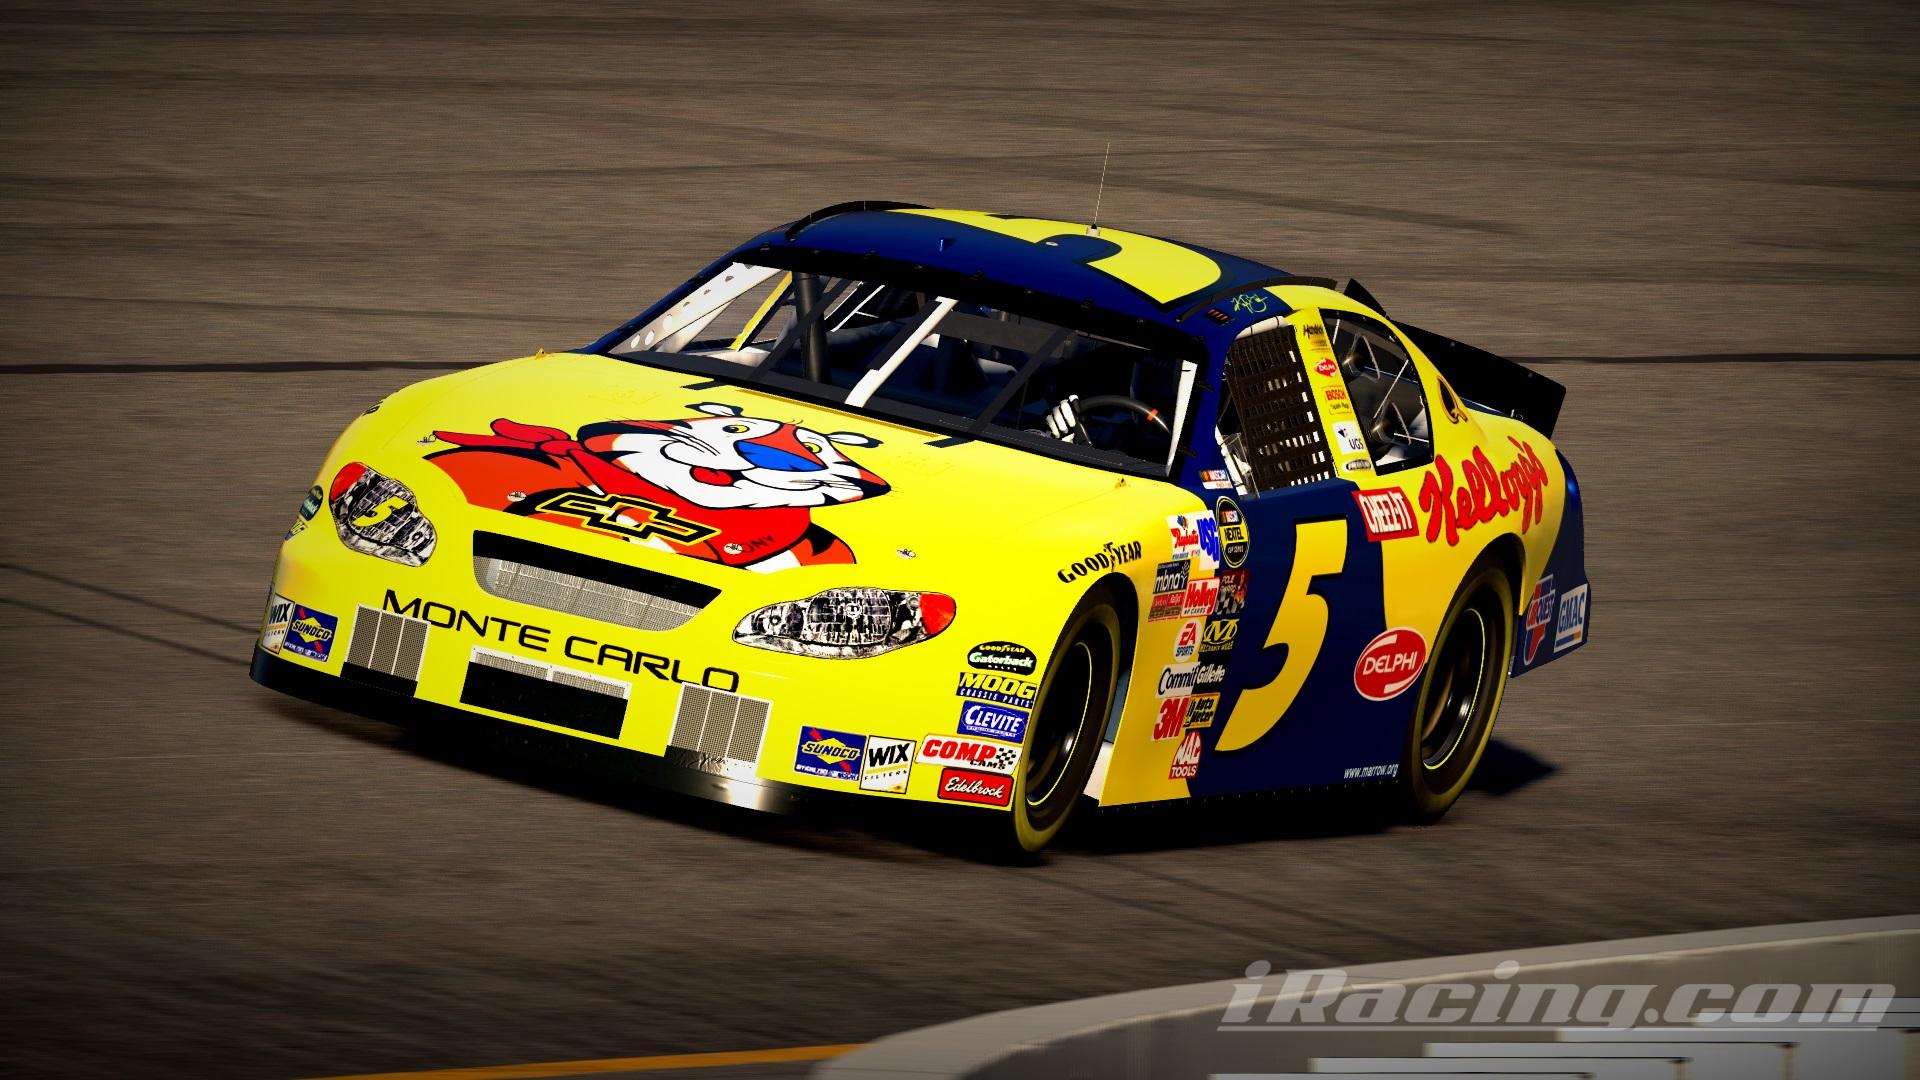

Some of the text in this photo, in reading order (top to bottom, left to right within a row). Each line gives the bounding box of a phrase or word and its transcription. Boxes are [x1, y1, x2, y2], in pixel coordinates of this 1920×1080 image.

[1349, 438, 1364, 449] UGS
[1418, 435, 1548, 547] Kellogg's
[352, 496, 409, 528] 5
[1224, 526, 1245, 541] NEXTEL
[1154, 569, 1181, 593] mbna
[1559, 592, 1585, 634] GMAC
[293, 621, 331, 640] SUNOCO
[382, 589, 740, 693] MONTE CARLO
[1214, 518, 1348, 752] 5
[969, 651, 1034, 668] Gatorback
[1175, 646, 1194, 657] SPORTS
[1362, 651, 1418, 675] DELPHI
[1158, 664, 1199, 695] Commit
[1197, 664, 1226, 684] Gillette
[959, 672, 1037, 700] MOOG
[960, 688, 1030, 707] CHASSIS PARTS
[1195, 698, 1214, 711] Auto
[965, 705, 1023, 733] CLEVITE
[1153, 697, 1189, 740] 3M
[804, 743, 858, 759] SUNOCO
[868, 743, 909, 767] WIX
[922, 739, 997, 763] COMP
[864, 769, 908, 781] FILTERS
[1171, 765, 1197, 777] TOOLS
[1343, 763, 1400, 779] www.marrow.org
[945, 776, 1004, 798] Edelbrock
